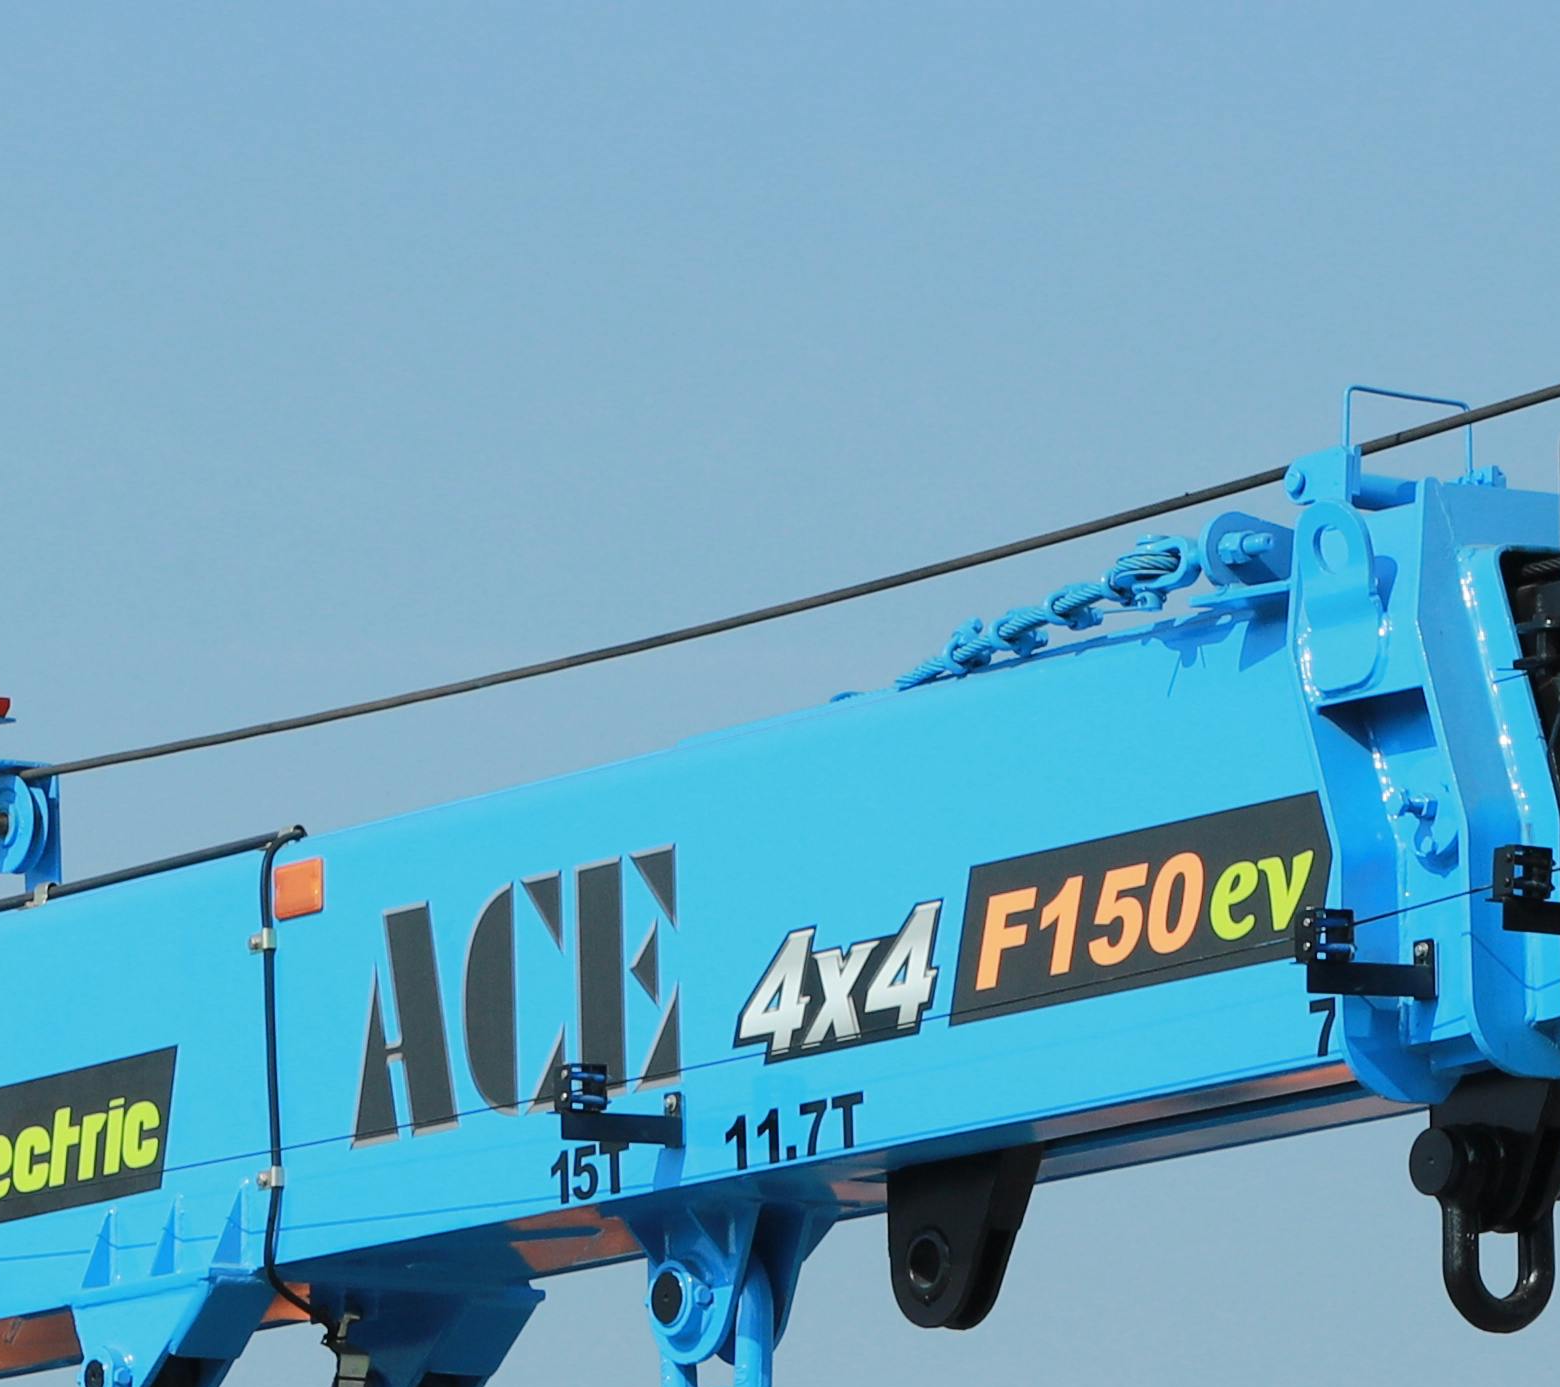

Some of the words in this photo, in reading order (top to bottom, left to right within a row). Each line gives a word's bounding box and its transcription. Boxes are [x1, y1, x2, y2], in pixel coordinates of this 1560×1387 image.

[350, 843, 682, 1149] ACE
[735, 900, 943, 1061] 4x4
[550, 1141, 630, 1205] 15T
[725, 1091, 864, 1171] 11.7T
